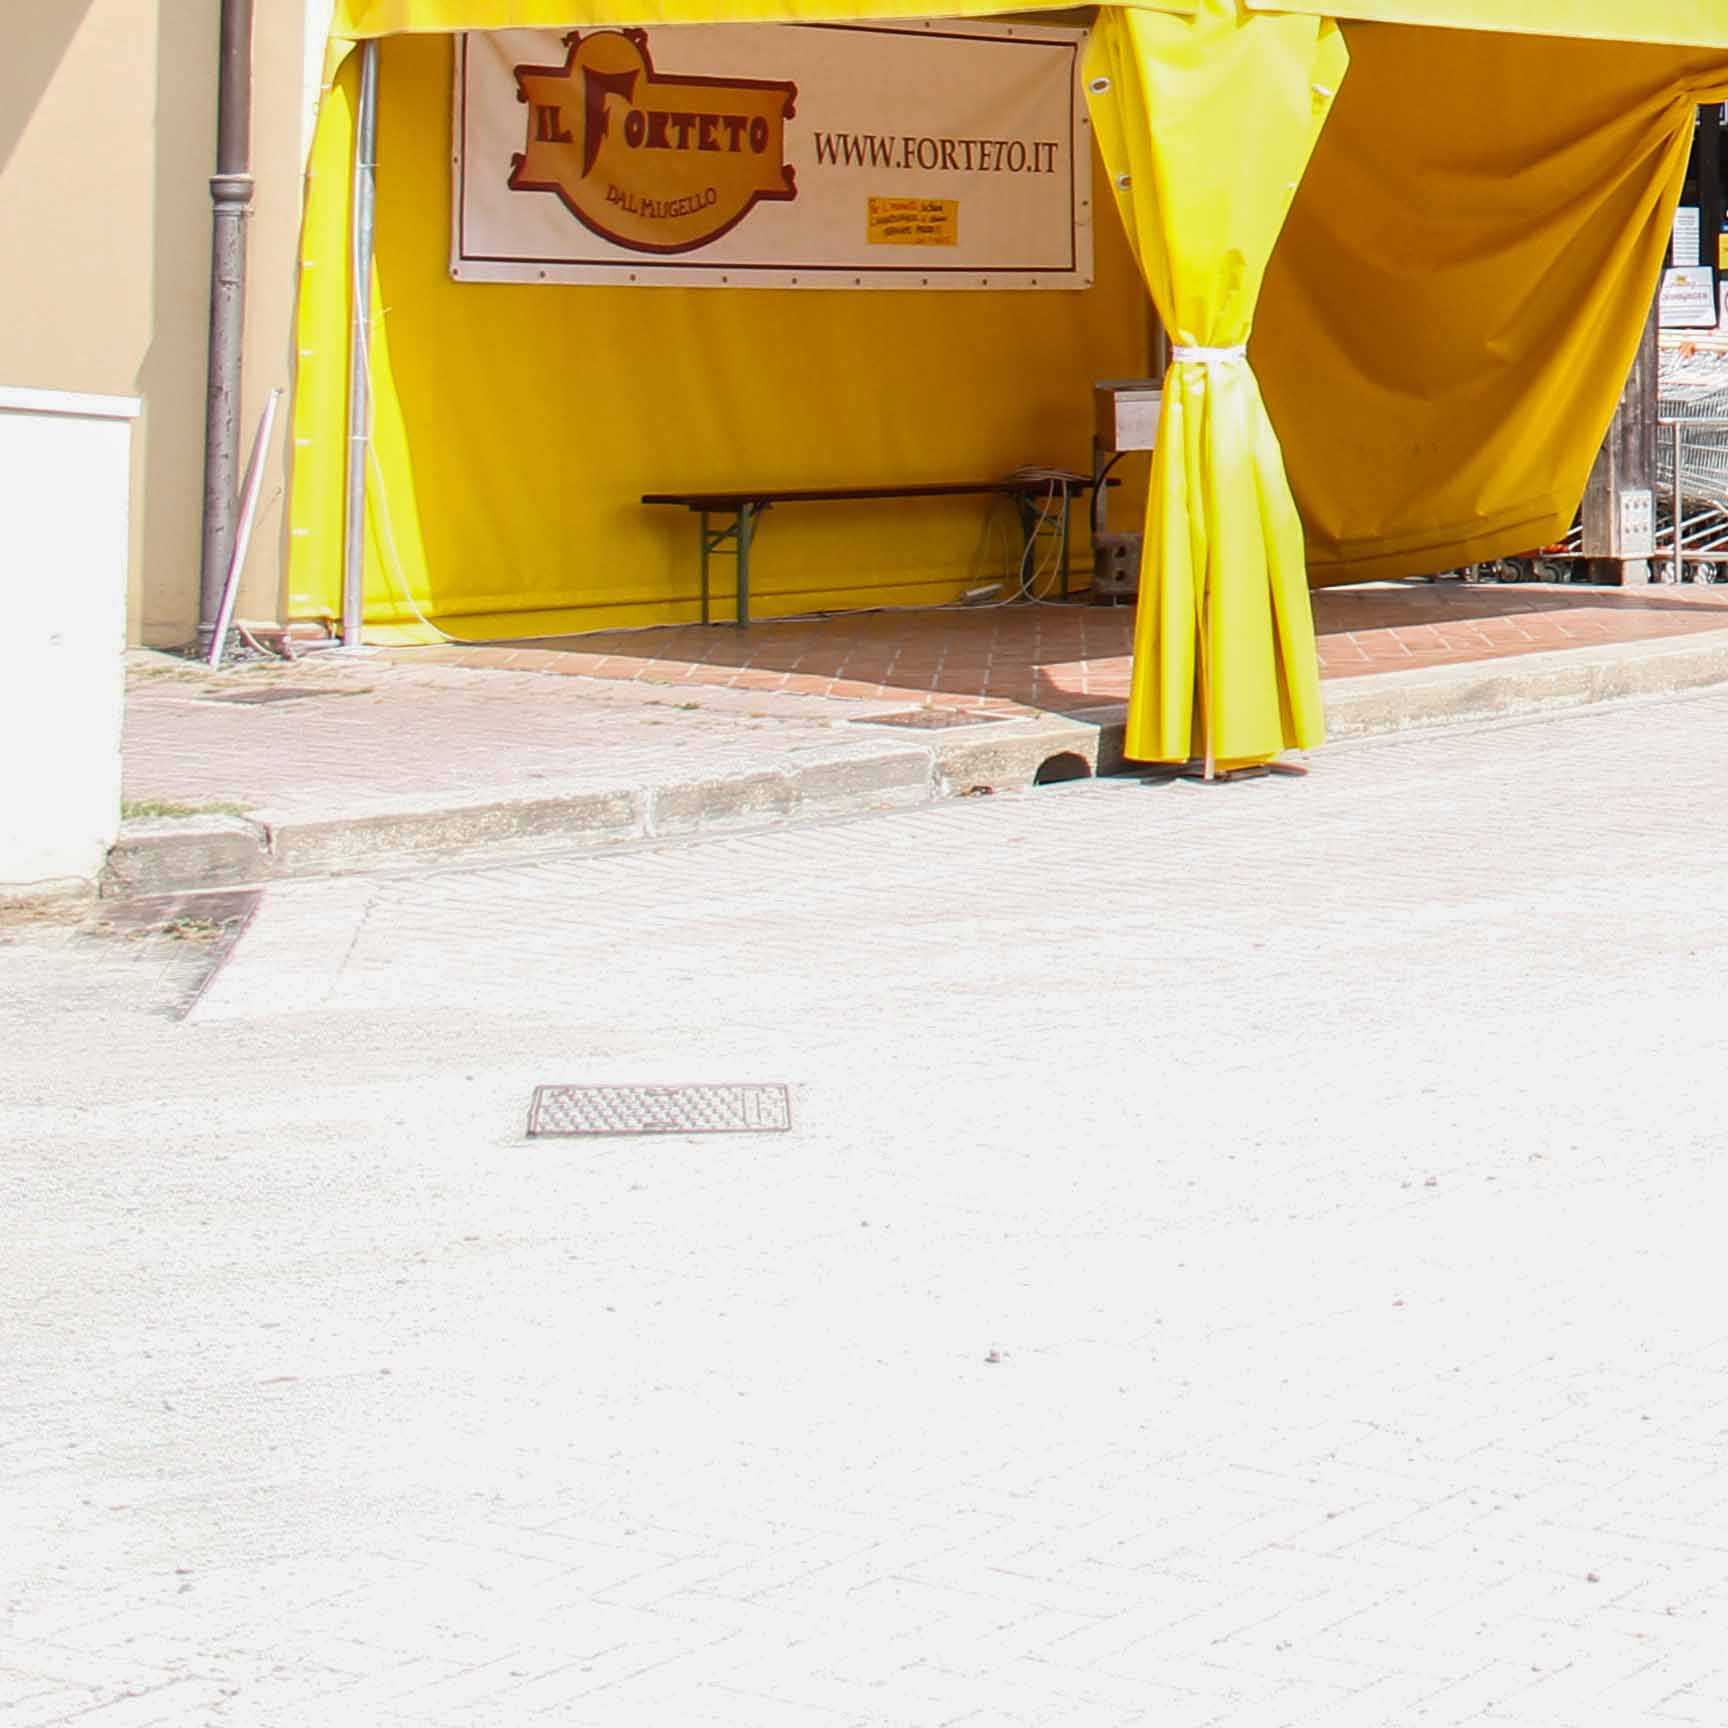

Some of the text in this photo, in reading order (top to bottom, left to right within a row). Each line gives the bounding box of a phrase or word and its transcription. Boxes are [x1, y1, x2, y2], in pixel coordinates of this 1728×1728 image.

[536, 63, 769, 179] IL FORTETO
[814, 132, 1059, 173] WWW.FORTETO.IT
[606, 183, 718, 219] DAL MUGELLO
